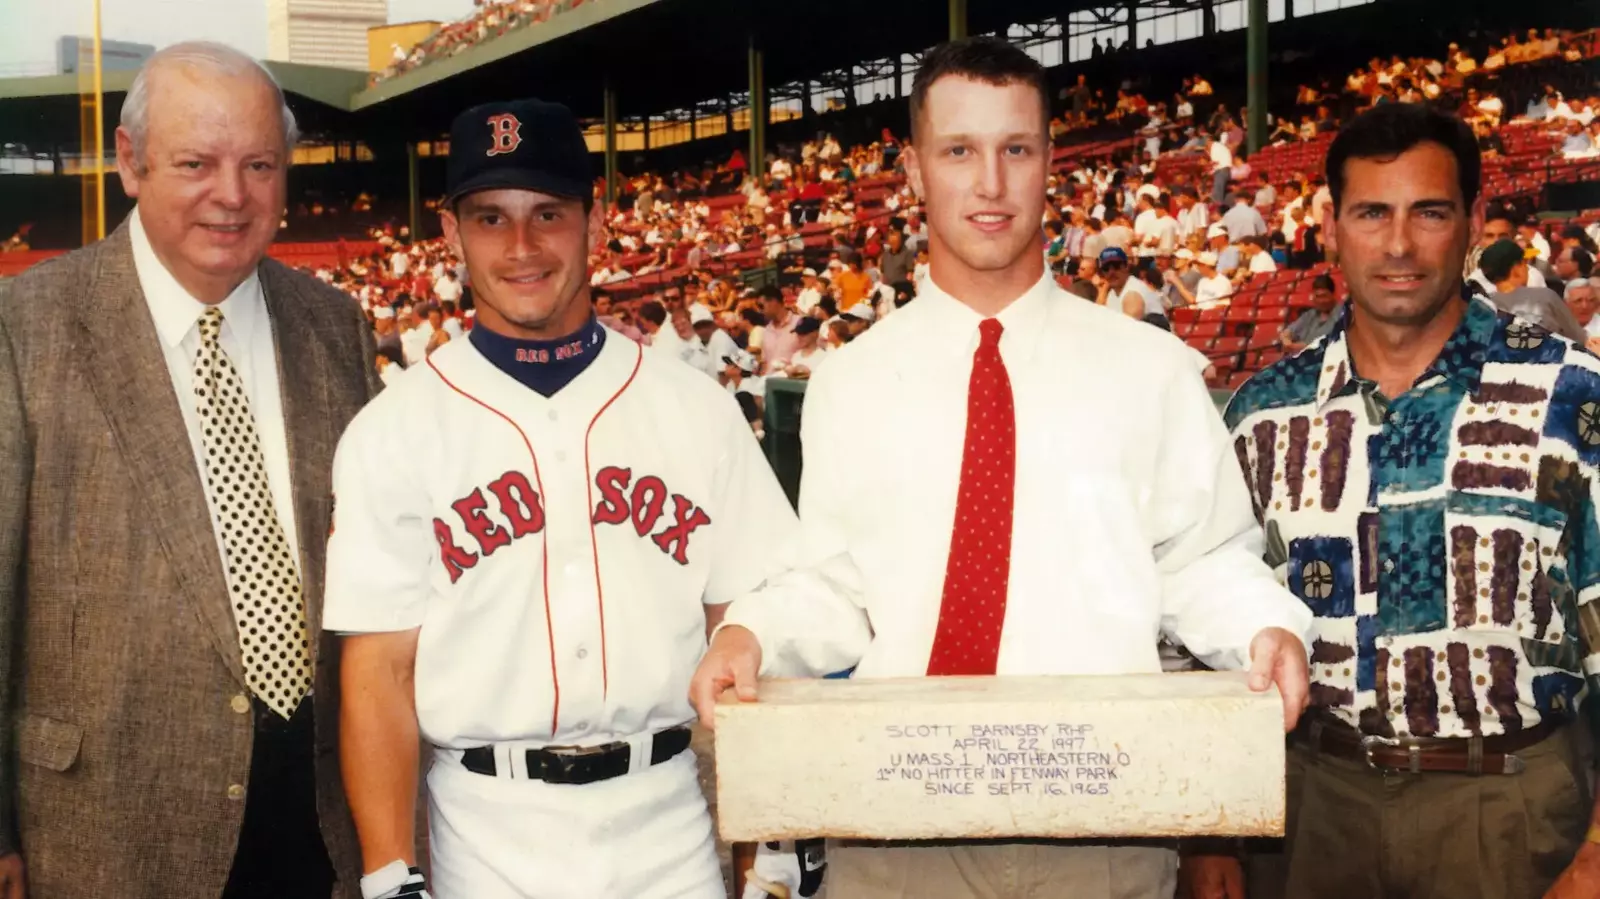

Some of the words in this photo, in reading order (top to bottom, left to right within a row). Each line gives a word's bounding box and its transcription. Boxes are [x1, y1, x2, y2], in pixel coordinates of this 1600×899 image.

[486, 113, 523, 157] B
[515, 348, 549, 364] RED
[555, 340, 584, 360] SOX
[433, 470, 545, 584] RED
[592, 466, 711, 565] SOX
[885, 724, 956, 738] SCOTT
[969, 724, 1048, 737] BARNSBY
[1056, 723, 1094, 736] RHP
[953, 738, 1008, 751] APRIL
[1051, 737, 1085, 750] 1997
[890, 753, 902, 767] U
[906, 752, 954, 766] MASS
[987, 752, 1110, 766] NORTHEASTERN
[901, 767, 922, 780] NO
[928, 767, 985, 780] HITTER
[991, 767, 1006, 780] IN
[1011, 767, 1069, 780] FENWAY
[924, 782, 974, 795] SINCE
[1070, 782, 1109, 795] 1965
